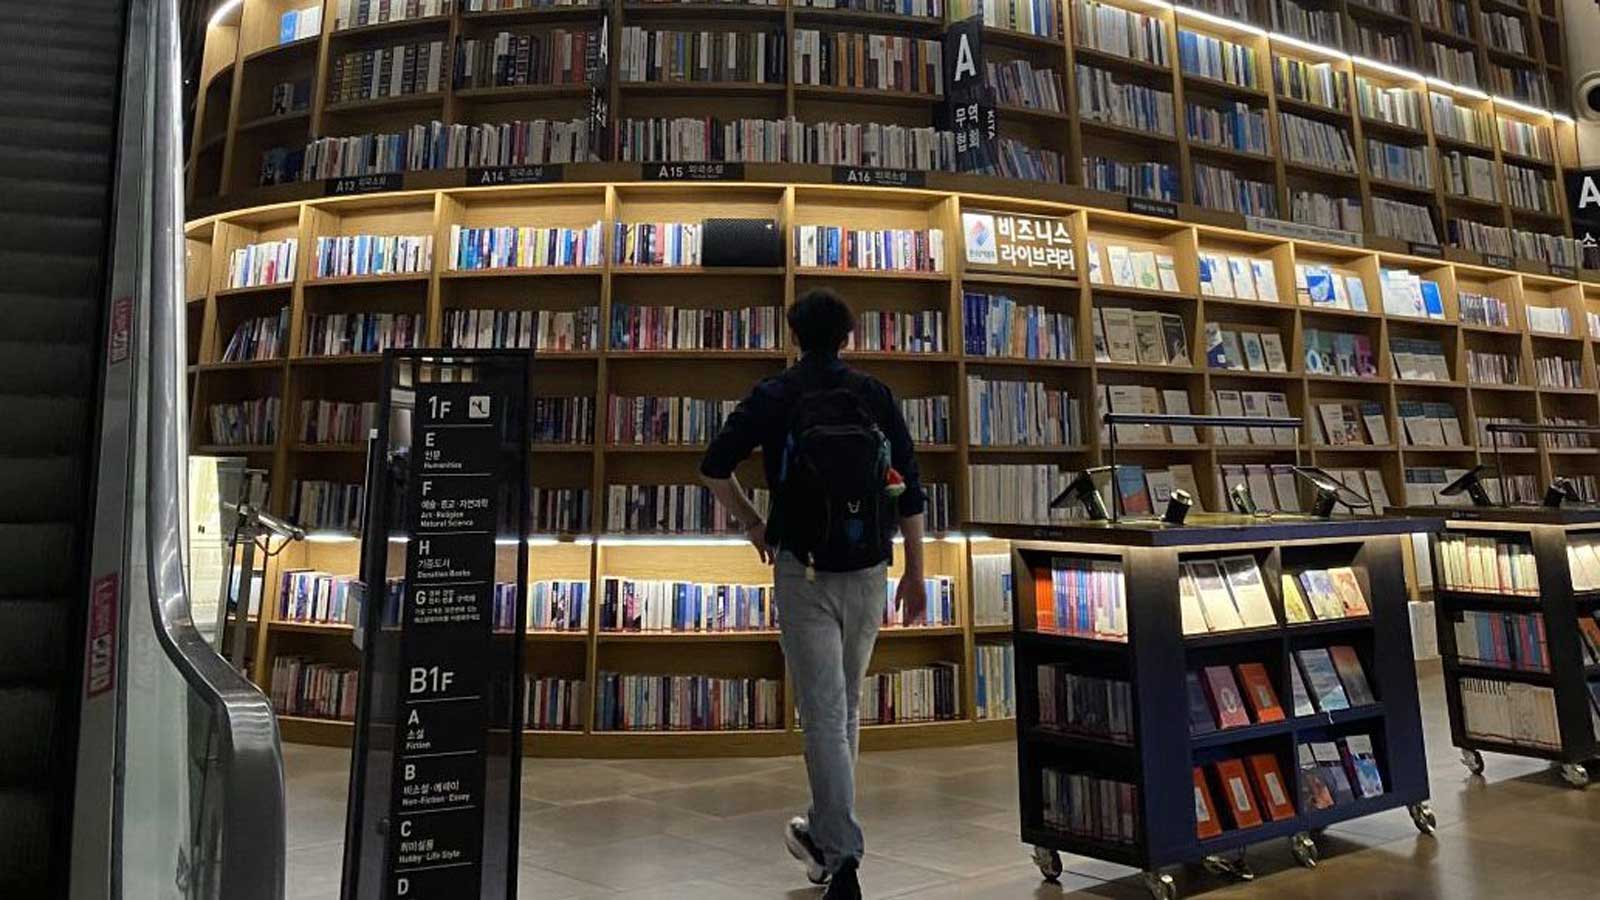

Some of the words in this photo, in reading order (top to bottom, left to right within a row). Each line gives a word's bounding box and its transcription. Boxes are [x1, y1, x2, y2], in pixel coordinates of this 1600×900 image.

[954, 34, 976, 82] A
[480, 169, 504, 184] A14
[658, 165, 683, 178] A15
[847, 169, 871, 183] A16
[1578, 176, 1600, 208] A
[998, 216, 1072, 245] 비즈니스
[1000, 244, 1075, 271] 라이브러리
[428, 396, 452, 419] 1F
[425, 432, 436, 447] E
[422, 481, 432, 496] F
[420, 520, 447, 528] Natural
[419, 540, 430, 555] H
[415, 590, 426, 605] G
[410, 665, 454, 694] B1F
[408, 709, 419, 725] A
[406, 729, 424, 740] 소설
[405, 741, 431, 750] Fiction
[404, 764, 416, 781] B
[400, 820, 412, 837] C
[397, 878, 409, 896] D
